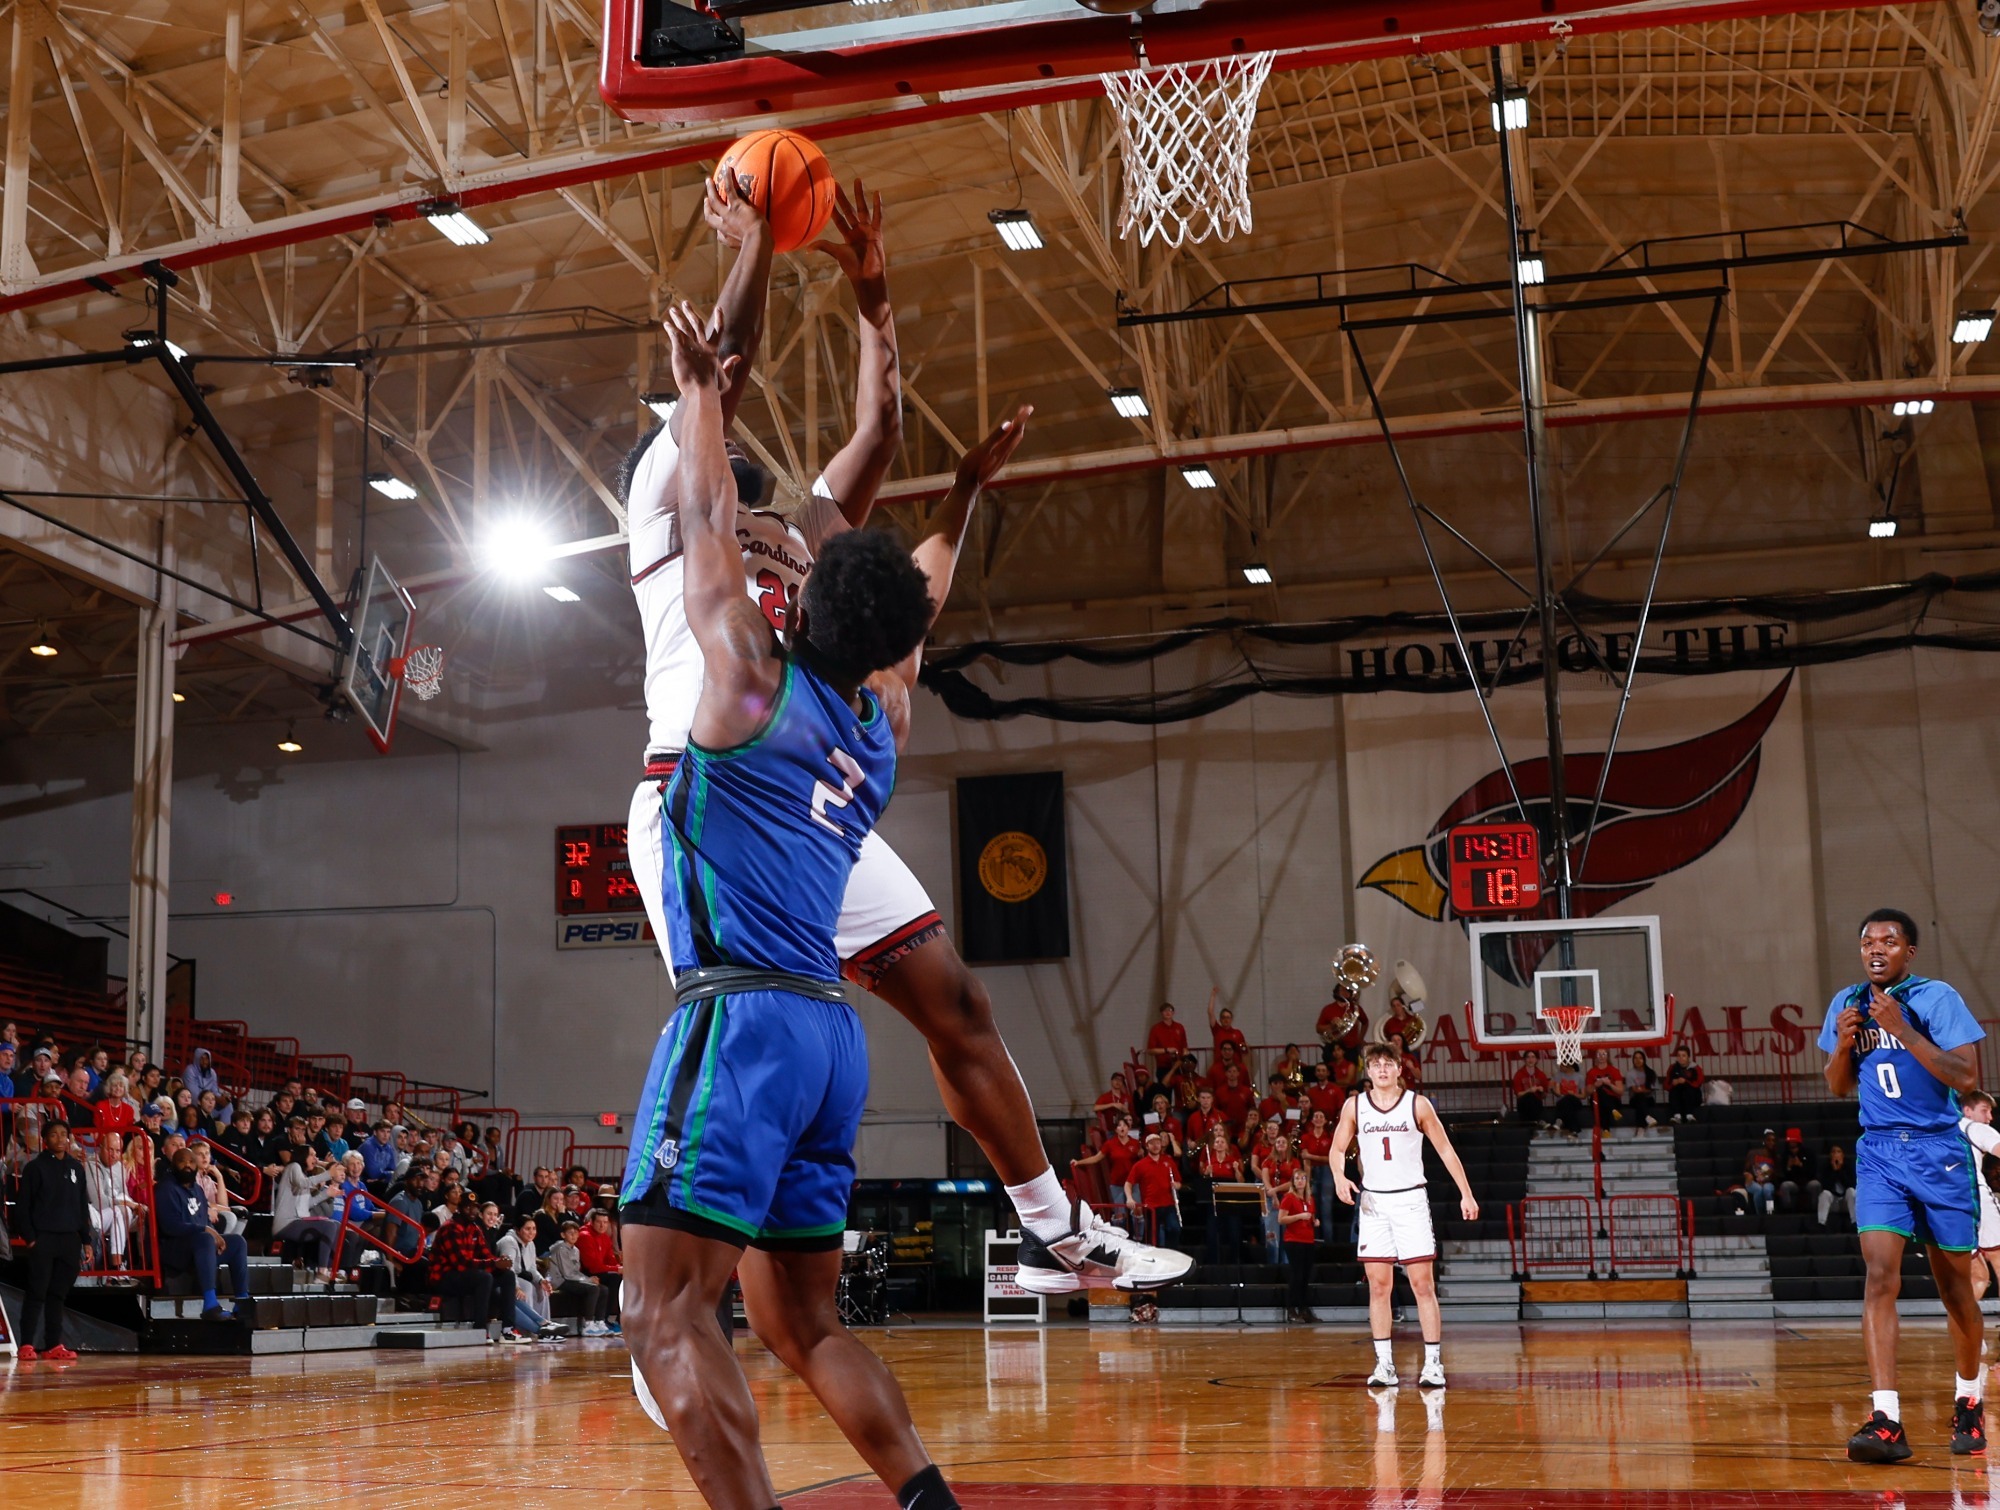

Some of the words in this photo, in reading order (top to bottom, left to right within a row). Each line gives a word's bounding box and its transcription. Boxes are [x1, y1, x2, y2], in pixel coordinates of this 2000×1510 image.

[756, 568, 801, 632] 2
[1347, 637, 1528, 681] HOME
[1557, 632, 1635, 672] OF
[1662, 622, 1789, 665] THE
[809, 746, 867, 838] 2
[565, 842, 591, 867] 32
[1465, 833, 1532, 860] 14:30
[571, 879, 583, 898] 0
[1486, 868, 1519, 905] 18
[564, 922, 639, 943] PEPSI
[1876, 1062, 1902, 1099] 0
[1363, 1120, 1409, 1134] Cardinals
[1382, 1136, 1392, 1161] 1
